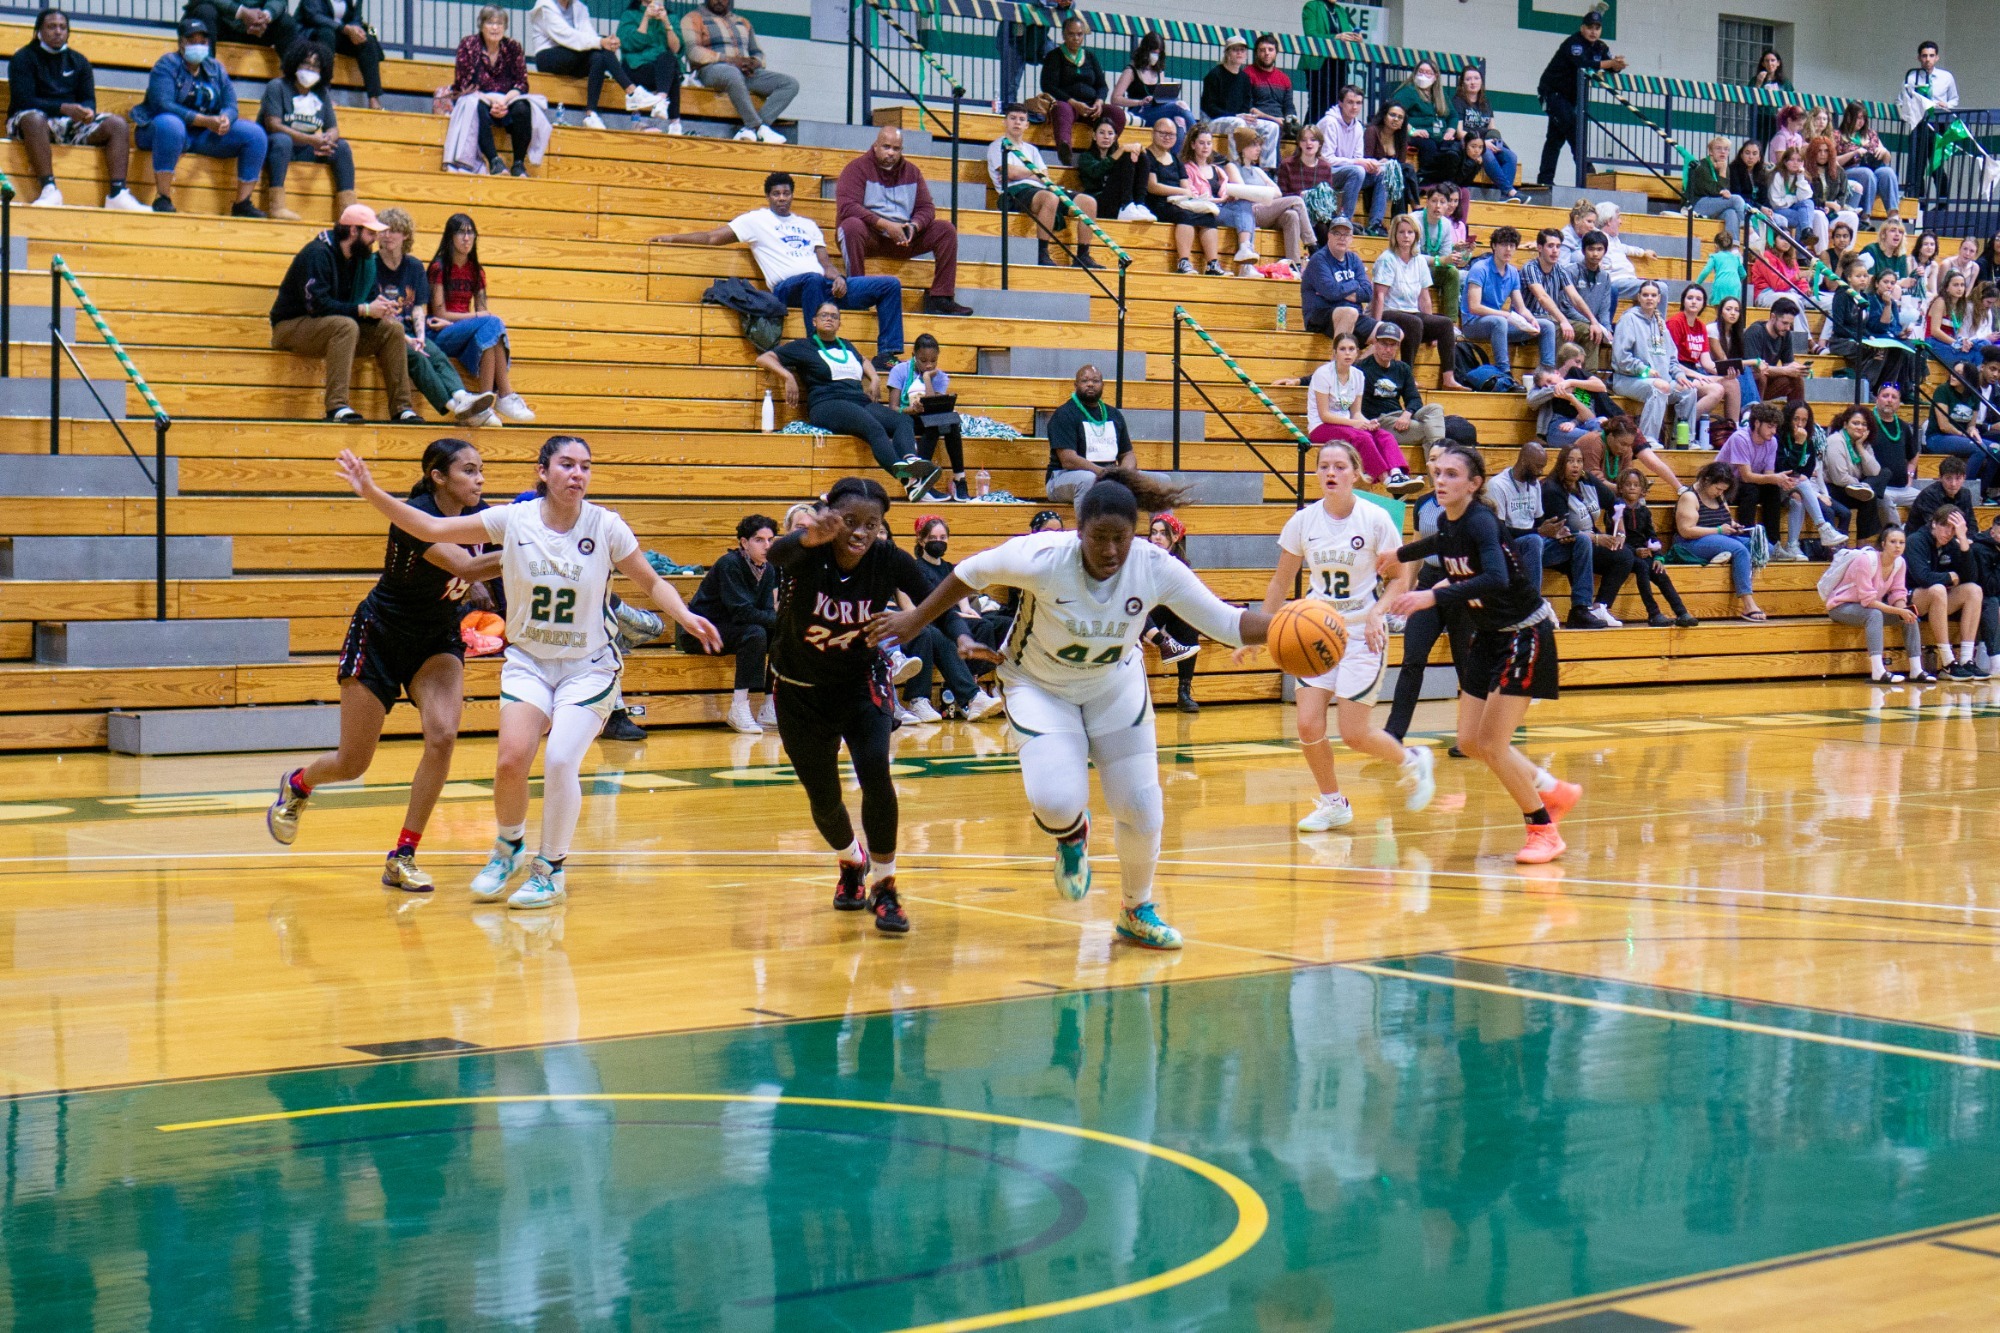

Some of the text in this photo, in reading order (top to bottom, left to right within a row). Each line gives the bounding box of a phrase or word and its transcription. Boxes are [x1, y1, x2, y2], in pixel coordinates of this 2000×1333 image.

[528, 559, 583, 582] SARAH
[1313, 550, 1357, 567] SARAH
[1321, 570, 1350, 599] 12
[530, 584, 577, 624] 22
[813, 591, 873, 625] YORK
[803, 624, 861, 653] 24
[1066, 619, 1130, 639] SARAH
[1056, 643, 1124, 664] 44
